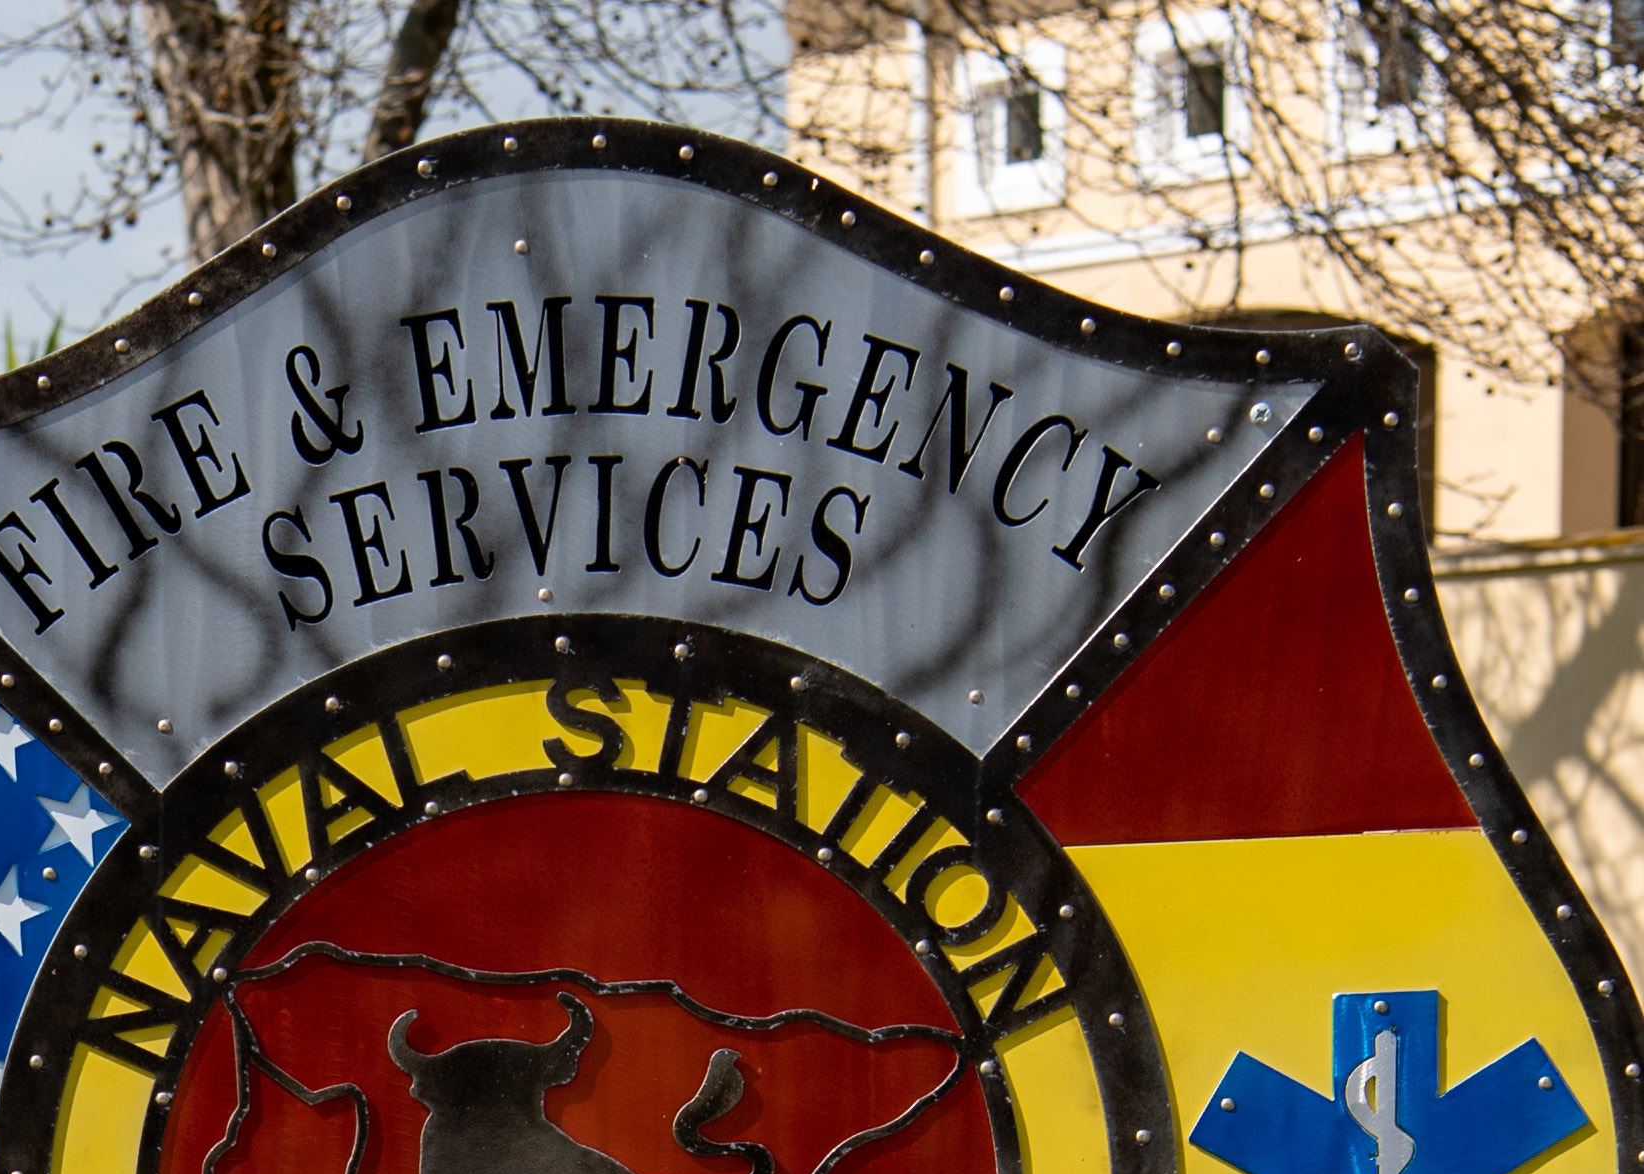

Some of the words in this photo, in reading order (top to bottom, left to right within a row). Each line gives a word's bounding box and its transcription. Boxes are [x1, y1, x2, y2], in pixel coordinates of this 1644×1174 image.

[263, 454, 872, 632] SERVICES
[288, 344, 364, 467] &
[400, 295, 1160, 572] EMERGENCY
[78, 715, 476, 1059] NAVAL
[543, 676, 1067, 1044] STATION
